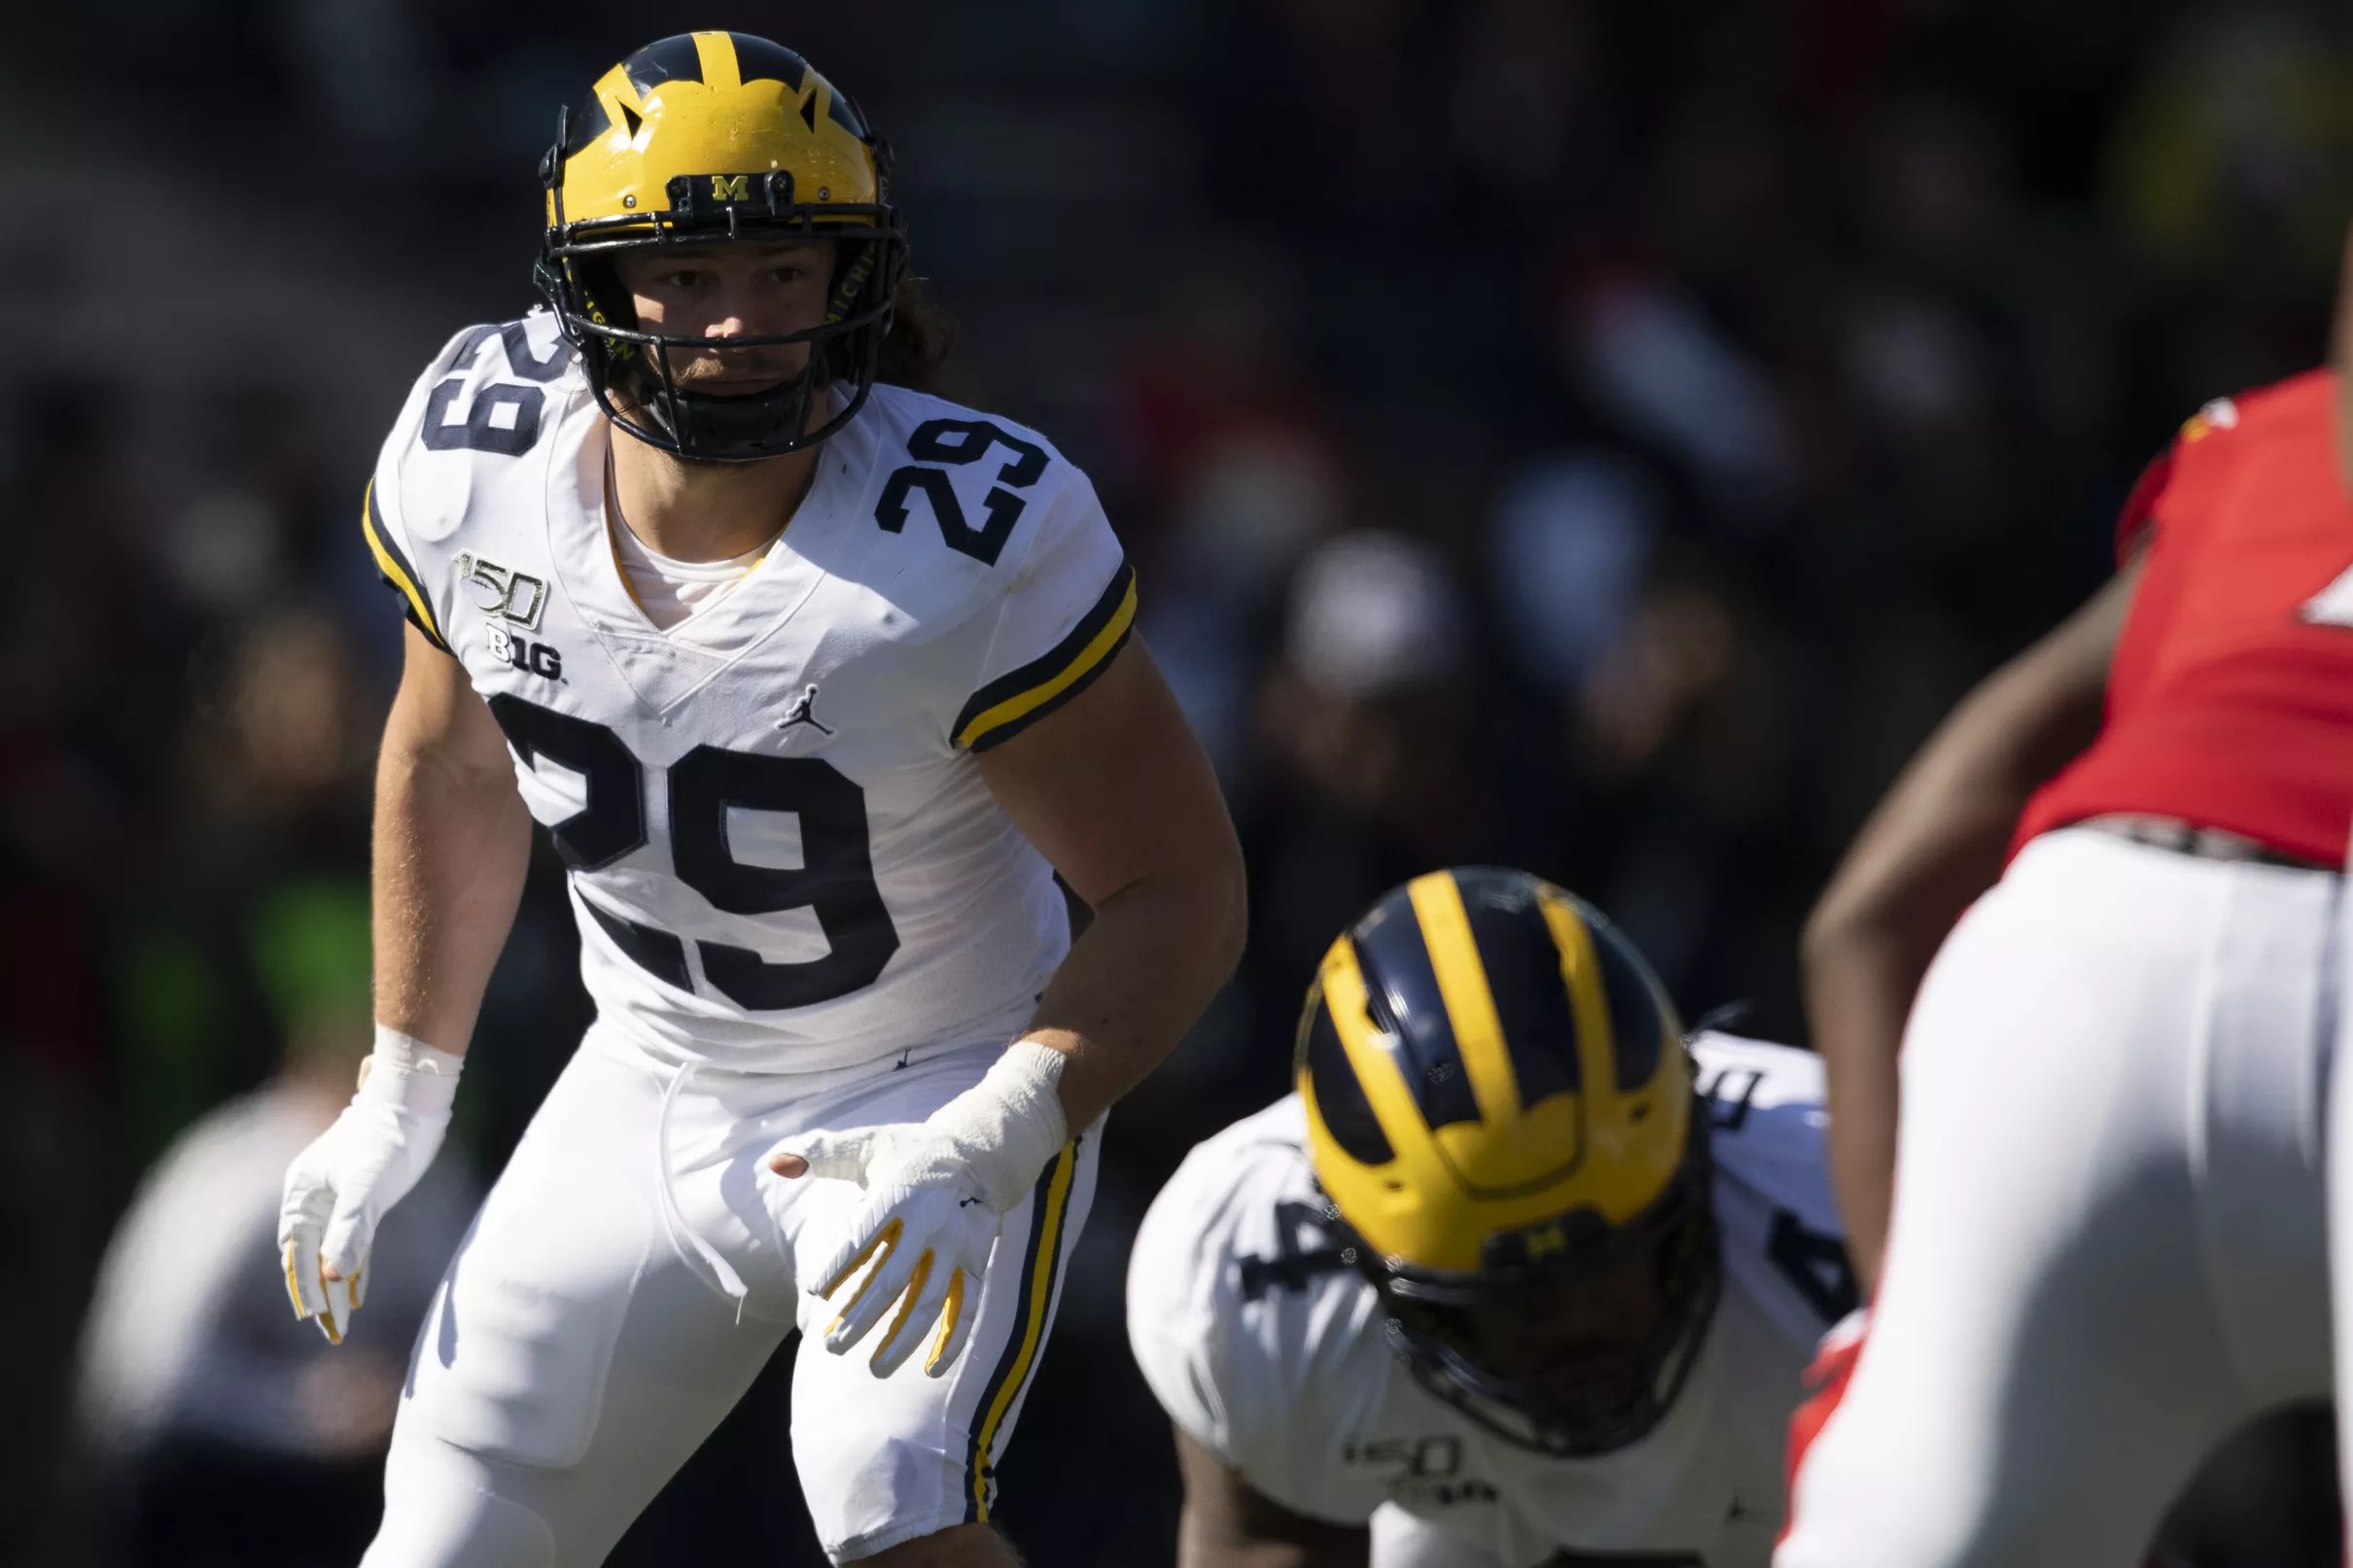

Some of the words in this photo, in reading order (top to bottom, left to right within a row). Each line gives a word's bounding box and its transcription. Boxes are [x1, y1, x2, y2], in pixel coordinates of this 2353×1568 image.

[711, 175, 749, 202] M
[823, 239, 877, 327] MICHI
[874, 418, 1051, 567] 29
[452, 551, 548, 631] 150
[487, 692, 900, 1011] 29
